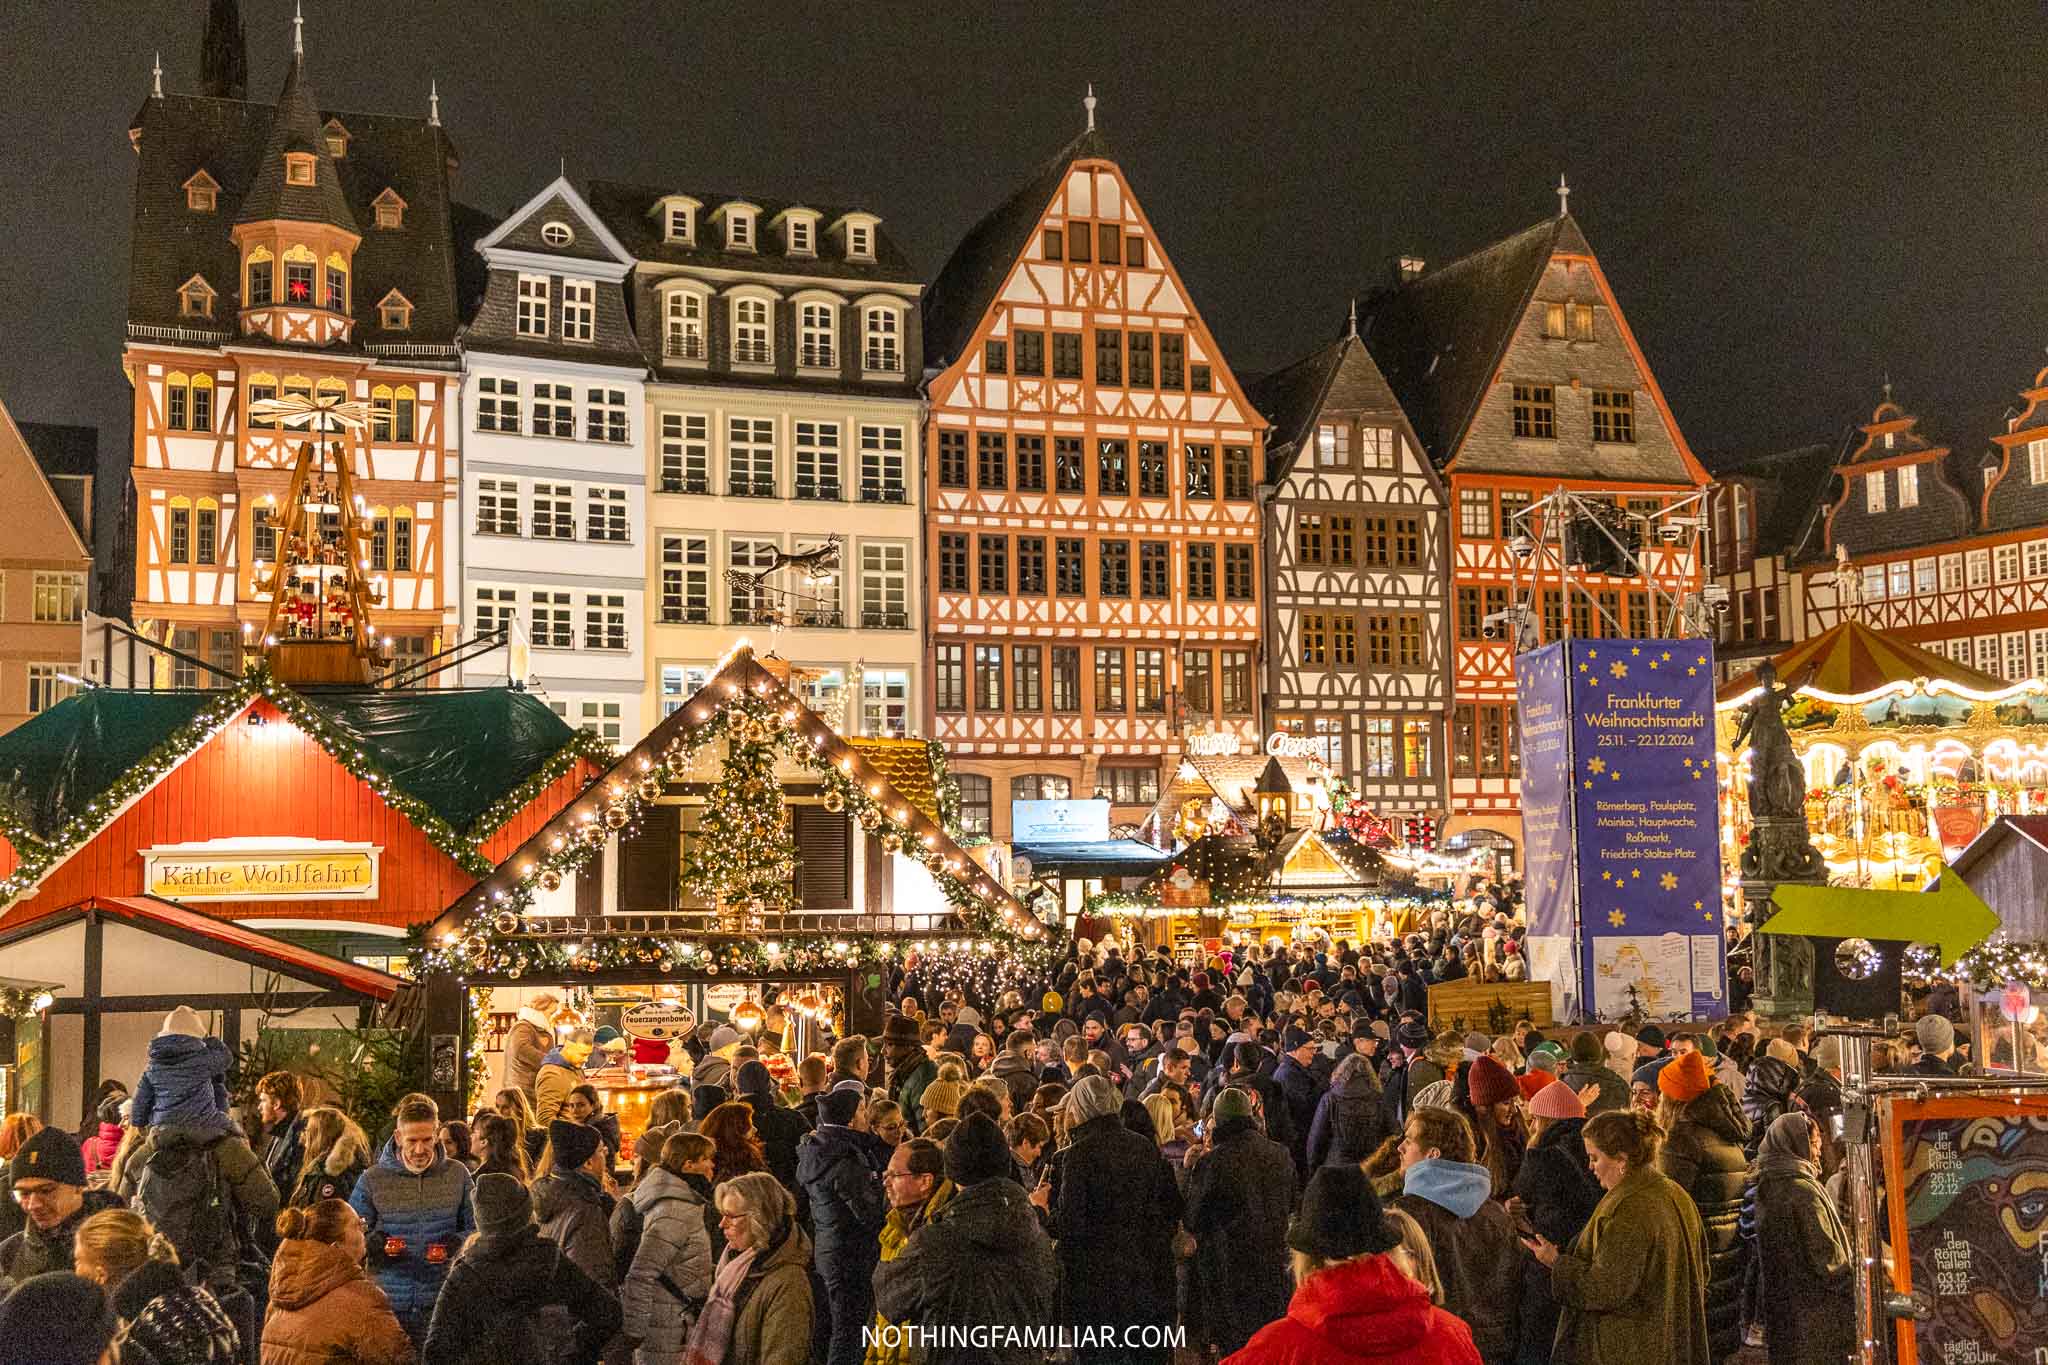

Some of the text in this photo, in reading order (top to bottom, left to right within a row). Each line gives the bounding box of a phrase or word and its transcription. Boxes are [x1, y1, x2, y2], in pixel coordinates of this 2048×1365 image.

[1607, 692, 1683, 709] Frankfurter
[1585, 711, 1704, 728] Weihnachtsmarkt
[1597, 734, 1627, 746] 25.11.
[1637, 734, 1695, 746] 22.12.2024
[1596, 800, 1697, 814] Römerberg, Paulsplatz,
[1597, 816, 1697, 830] Mainkai, Hauptwache,
[1625, 831, 1672, 845] Roßmarkt,
[162, 863, 363, 886] Käthe Wohlfahrt
[625, 1014, 691, 1024] Feuerzangenbowle
[1938, 1129, 1948, 1140] in
[1943, 1228, 1954, 1240] in
[1947, 1240, 1969, 1250] den
[1943, 1339, 1980, 1354] täglich
